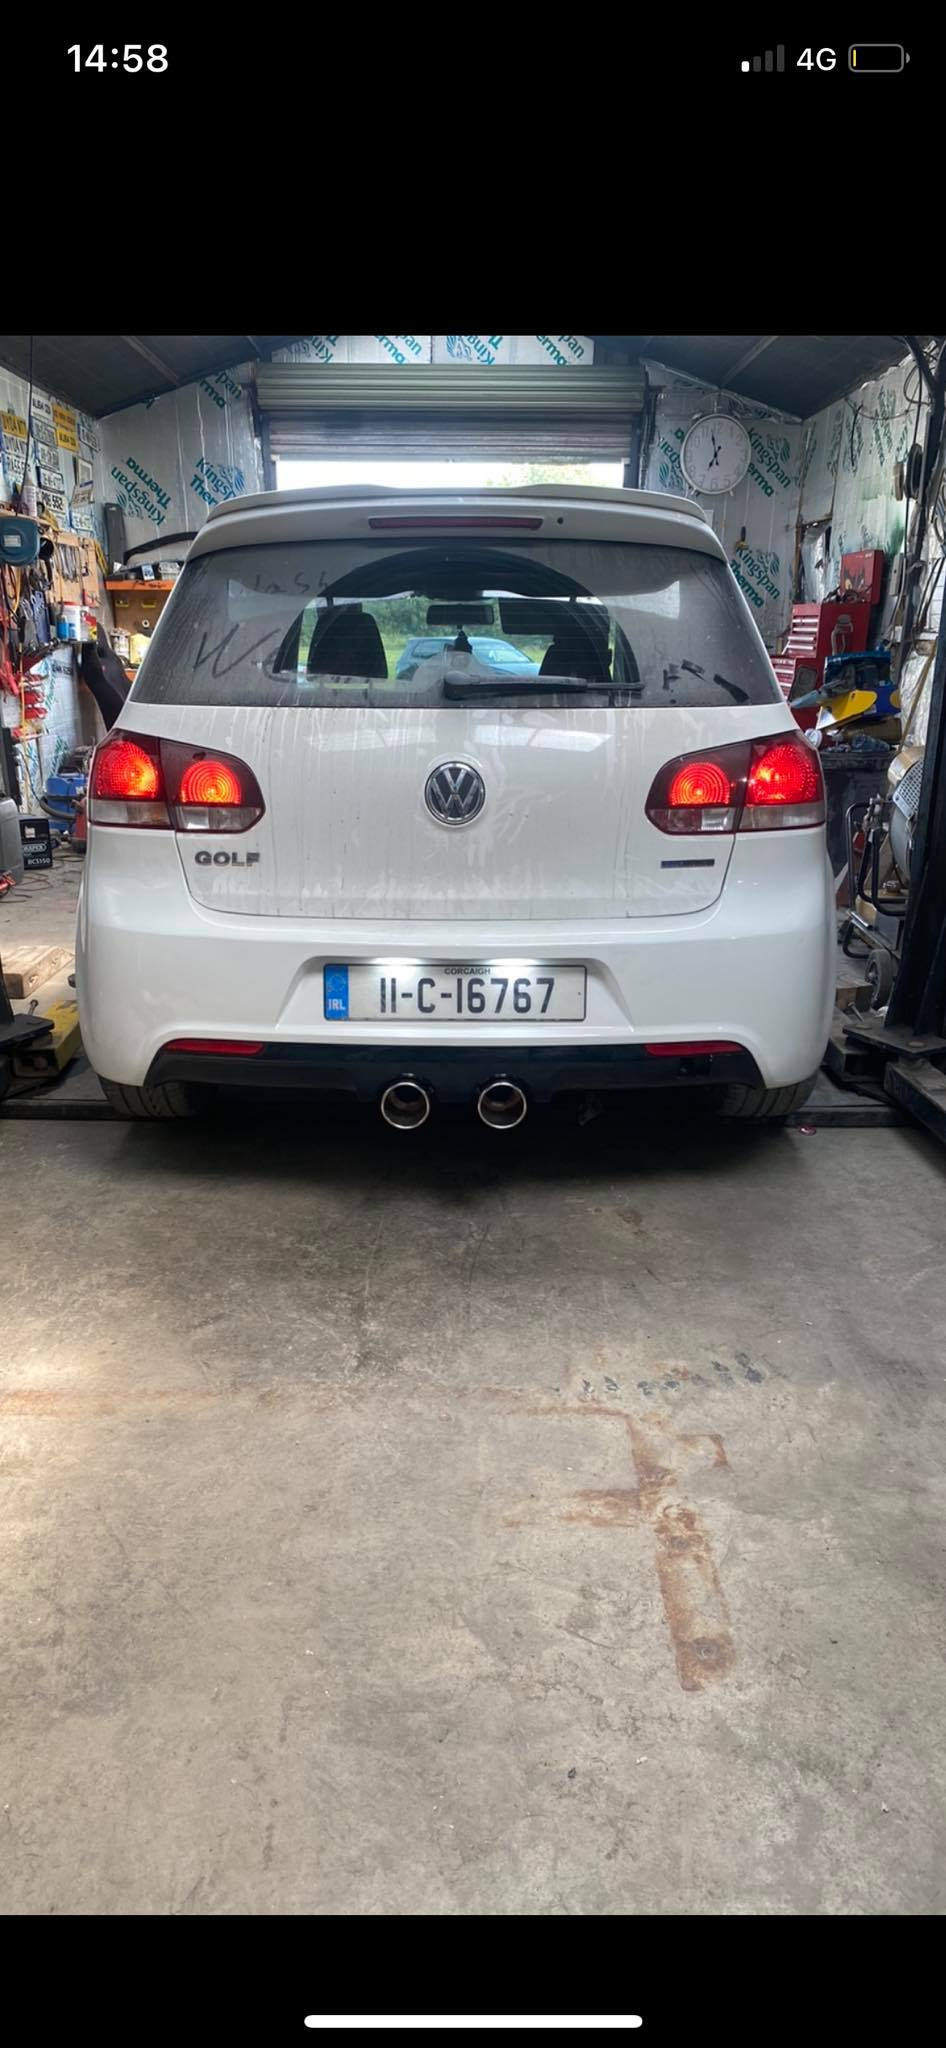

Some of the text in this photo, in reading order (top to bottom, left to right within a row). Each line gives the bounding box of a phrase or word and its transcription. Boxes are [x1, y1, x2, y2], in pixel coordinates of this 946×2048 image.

[110, 467, 165, 526] Kingspan
[126, 457, 172, 510] Therma
[190, 474, 219, 507] Ther
[748, 463, 775, 497] erma
[195, 852, 260, 866] GOLF
[444, 967, 491, 976] CORCAIGH
[328, 999, 346, 1011] IRL
[380, 977, 555, 1014] 11-C-16767
